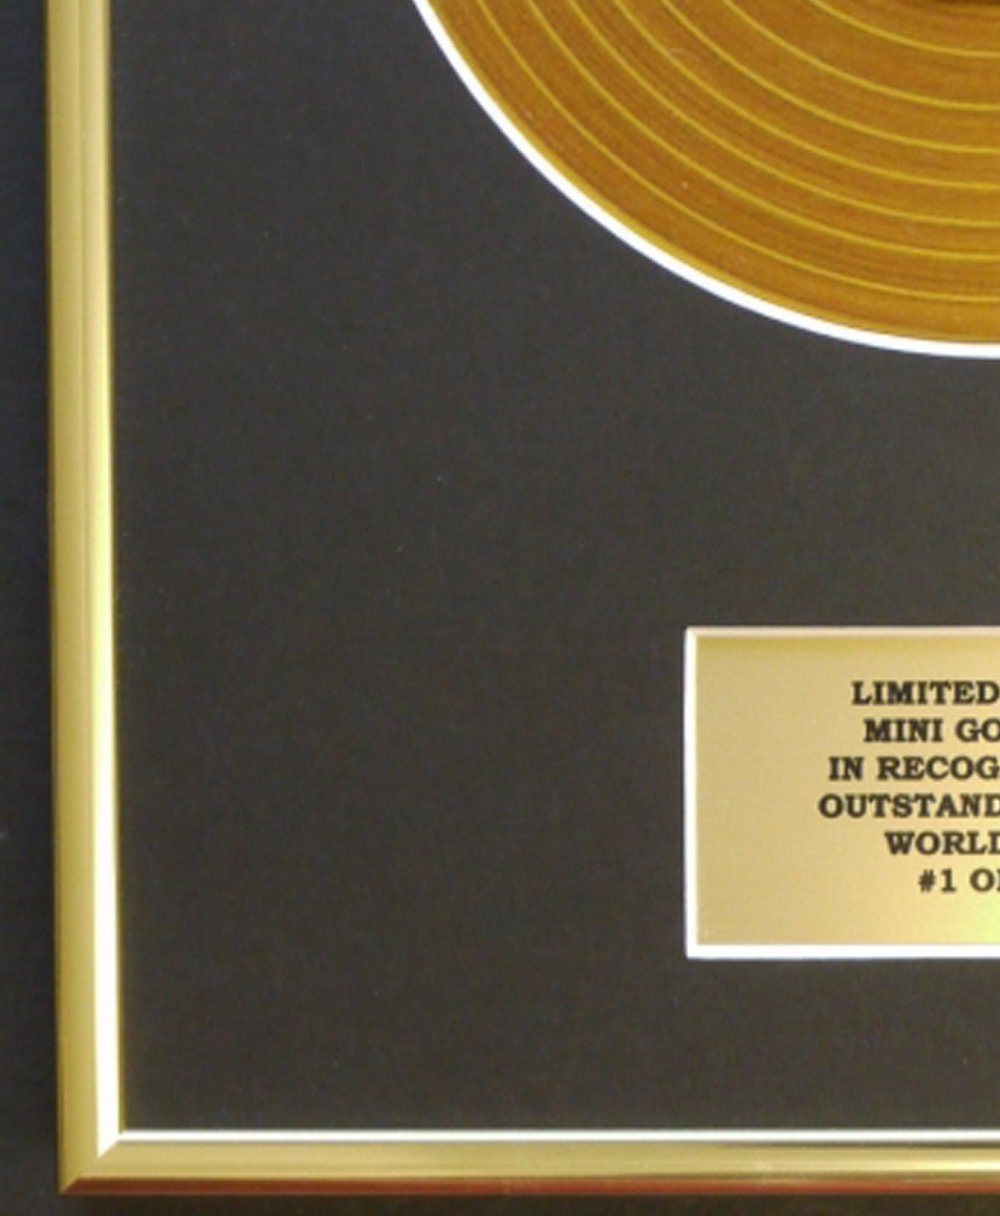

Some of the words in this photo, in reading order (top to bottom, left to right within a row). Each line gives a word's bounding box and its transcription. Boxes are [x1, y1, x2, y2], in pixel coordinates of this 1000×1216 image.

[852, 681, 1000, 706] LIMITED
[863, 718, 943, 743] MINI
[828, 756, 864, 781] IN
[918, 868, 956, 893] #1
